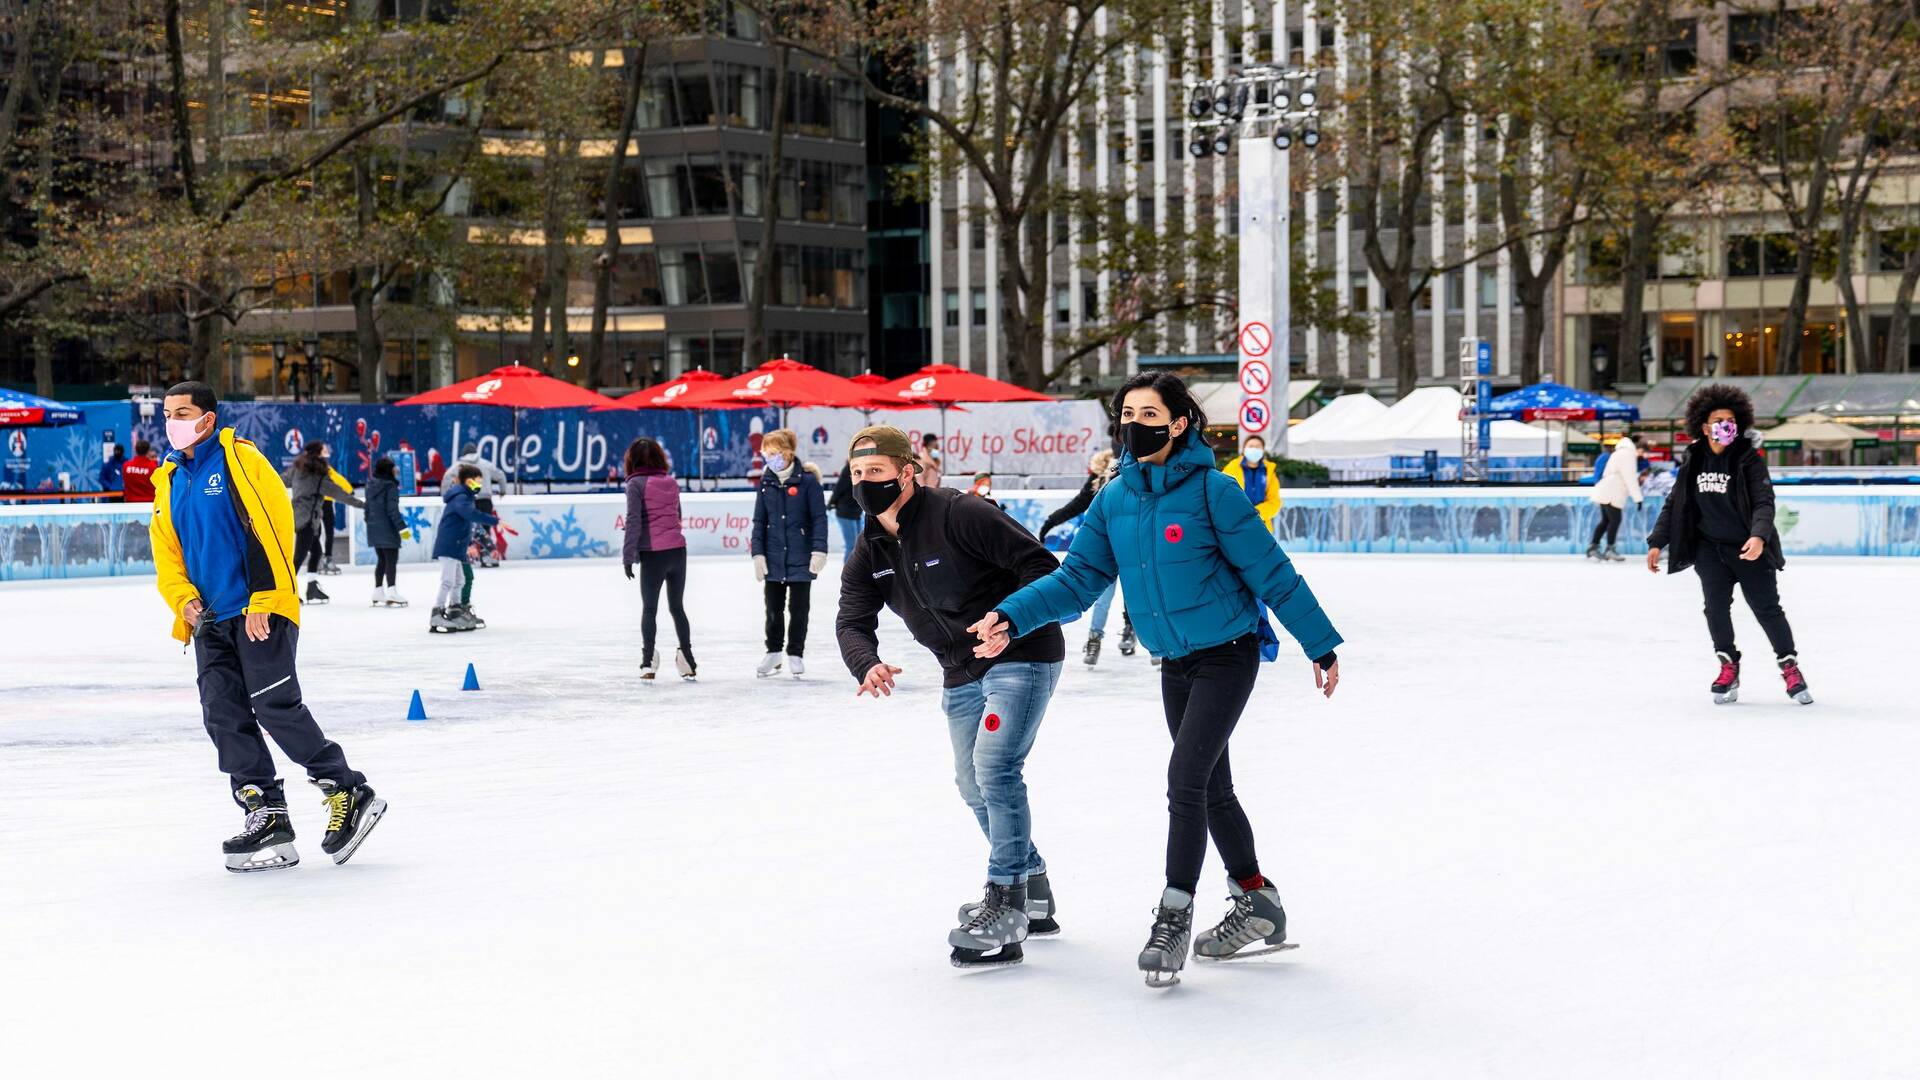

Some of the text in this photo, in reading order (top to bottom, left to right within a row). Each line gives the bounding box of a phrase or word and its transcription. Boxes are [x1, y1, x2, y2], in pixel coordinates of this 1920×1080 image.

[980, 432, 1005, 455] to
[1013, 427, 1093, 455] Skate?
[451, 420, 608, 484] Lace Up
[126, 466, 149, 475] STAFF
[726, 512, 750, 532] lap
[721, 534, 740, 549] to
